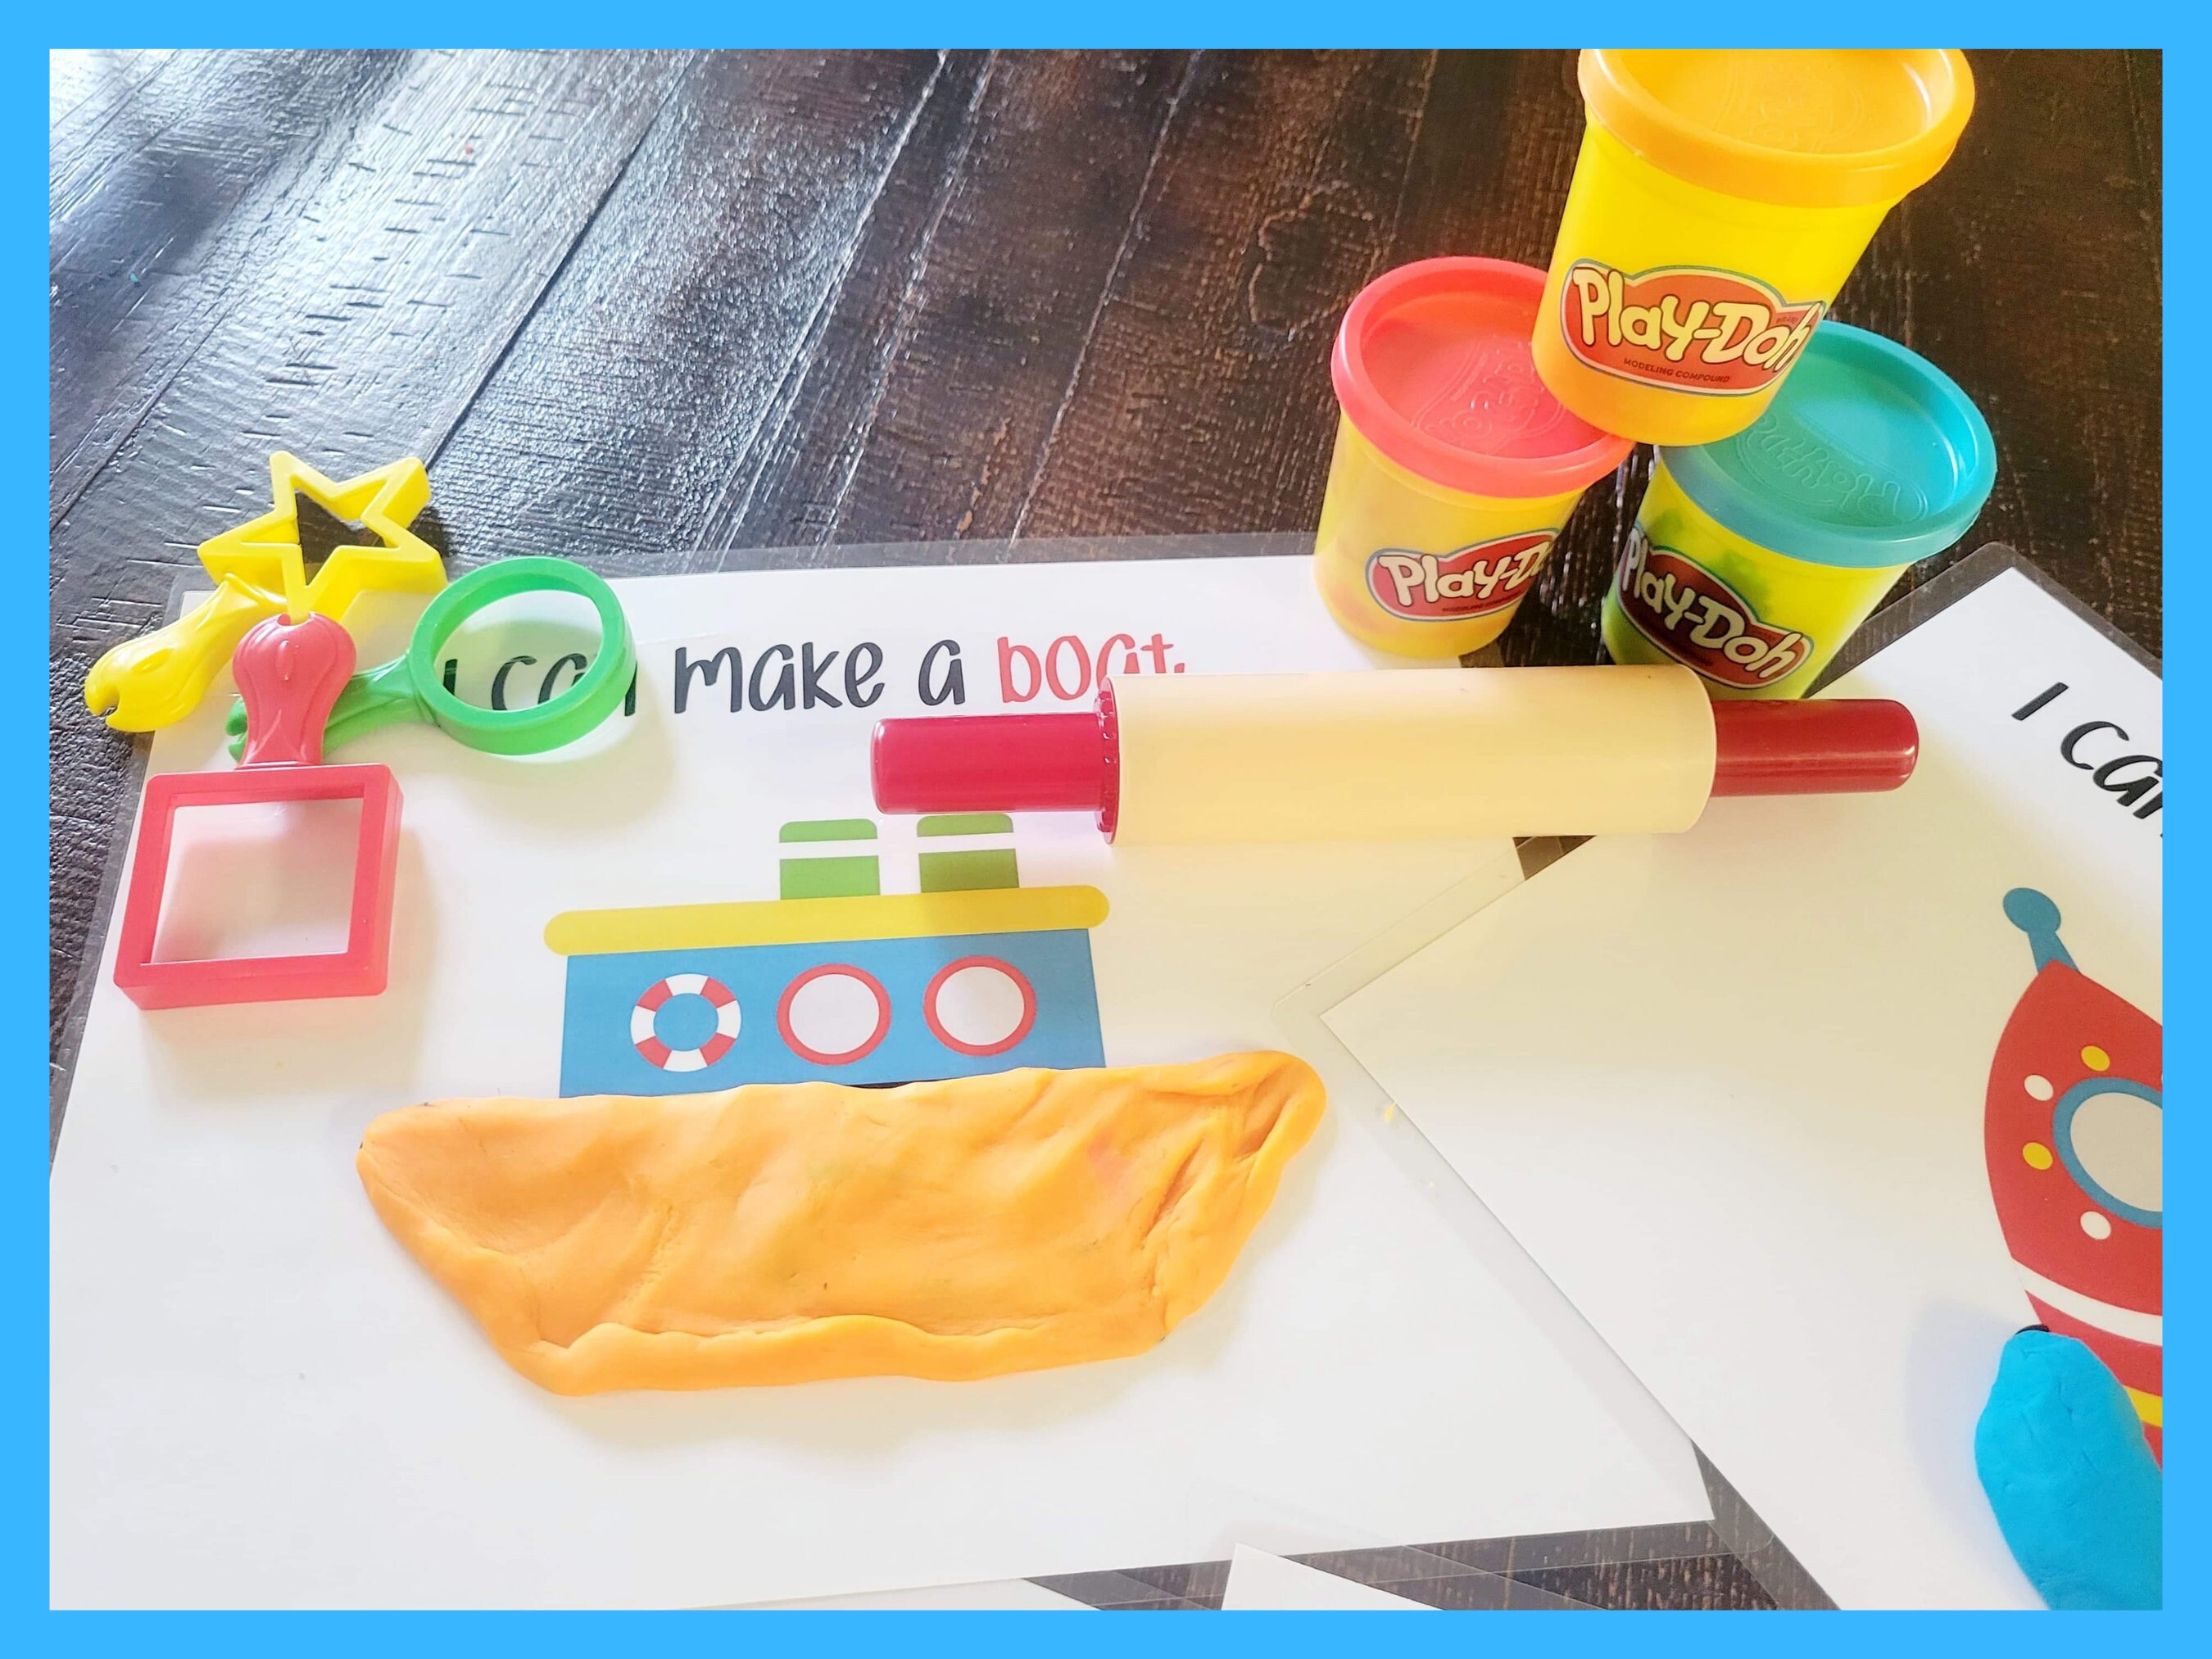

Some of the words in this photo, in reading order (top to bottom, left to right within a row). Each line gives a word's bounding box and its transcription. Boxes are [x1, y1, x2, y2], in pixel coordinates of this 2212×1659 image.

[1571, 266, 1822, 372] Play-Doh
[1623, 357, 1673, 376] MODELING
[1675, 369, 1729, 383] COMPOUND
[1621, 527, 1803, 678] Play-Doh
[674, 641, 885, 714] make
[918, 639, 966, 706] a
[2011, 682, 2069, 721] I
[2060, 720, 2163, 819] ca
